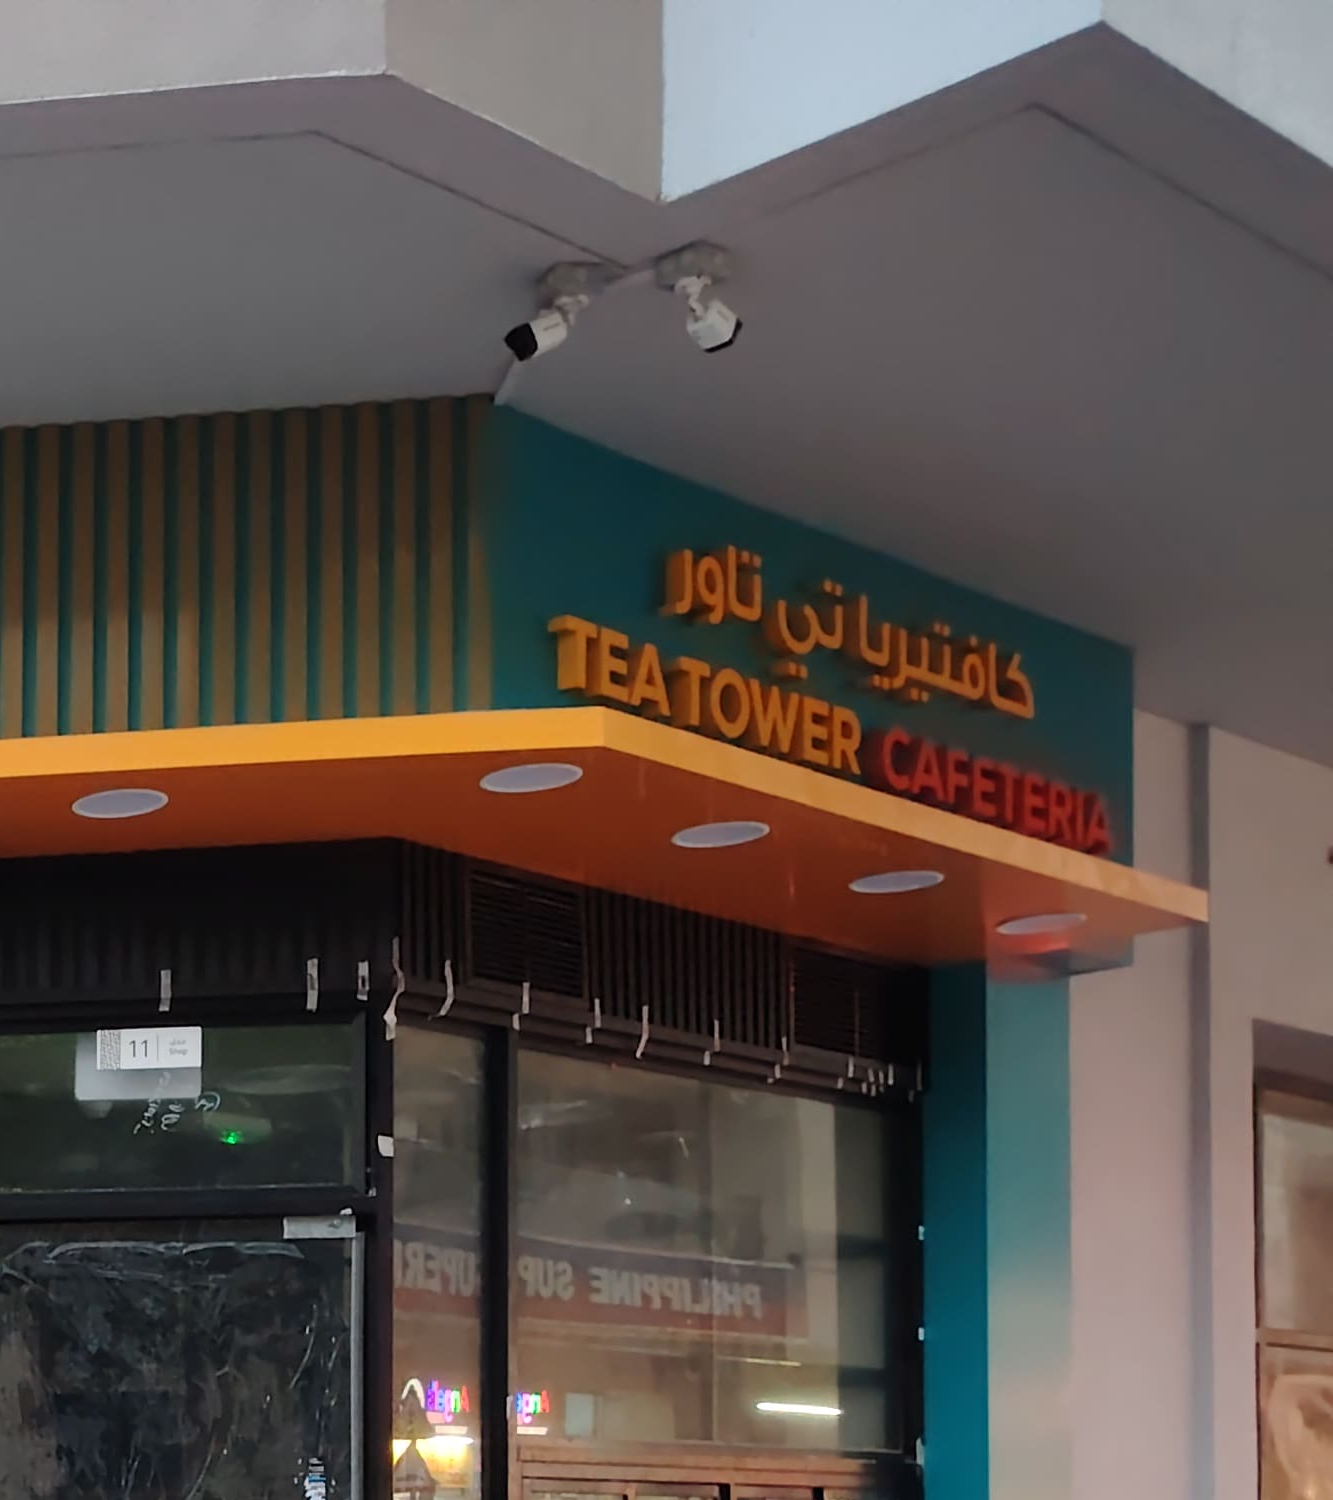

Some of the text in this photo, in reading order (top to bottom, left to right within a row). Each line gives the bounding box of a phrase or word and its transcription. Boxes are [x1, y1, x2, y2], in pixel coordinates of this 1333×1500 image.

[661, 545, 1035, 720] كافتيريا تي تاور
[547, 614, 1112, 854] TEA TOWER CAFETERIA
[128, 1039, 149, 1059] 11
